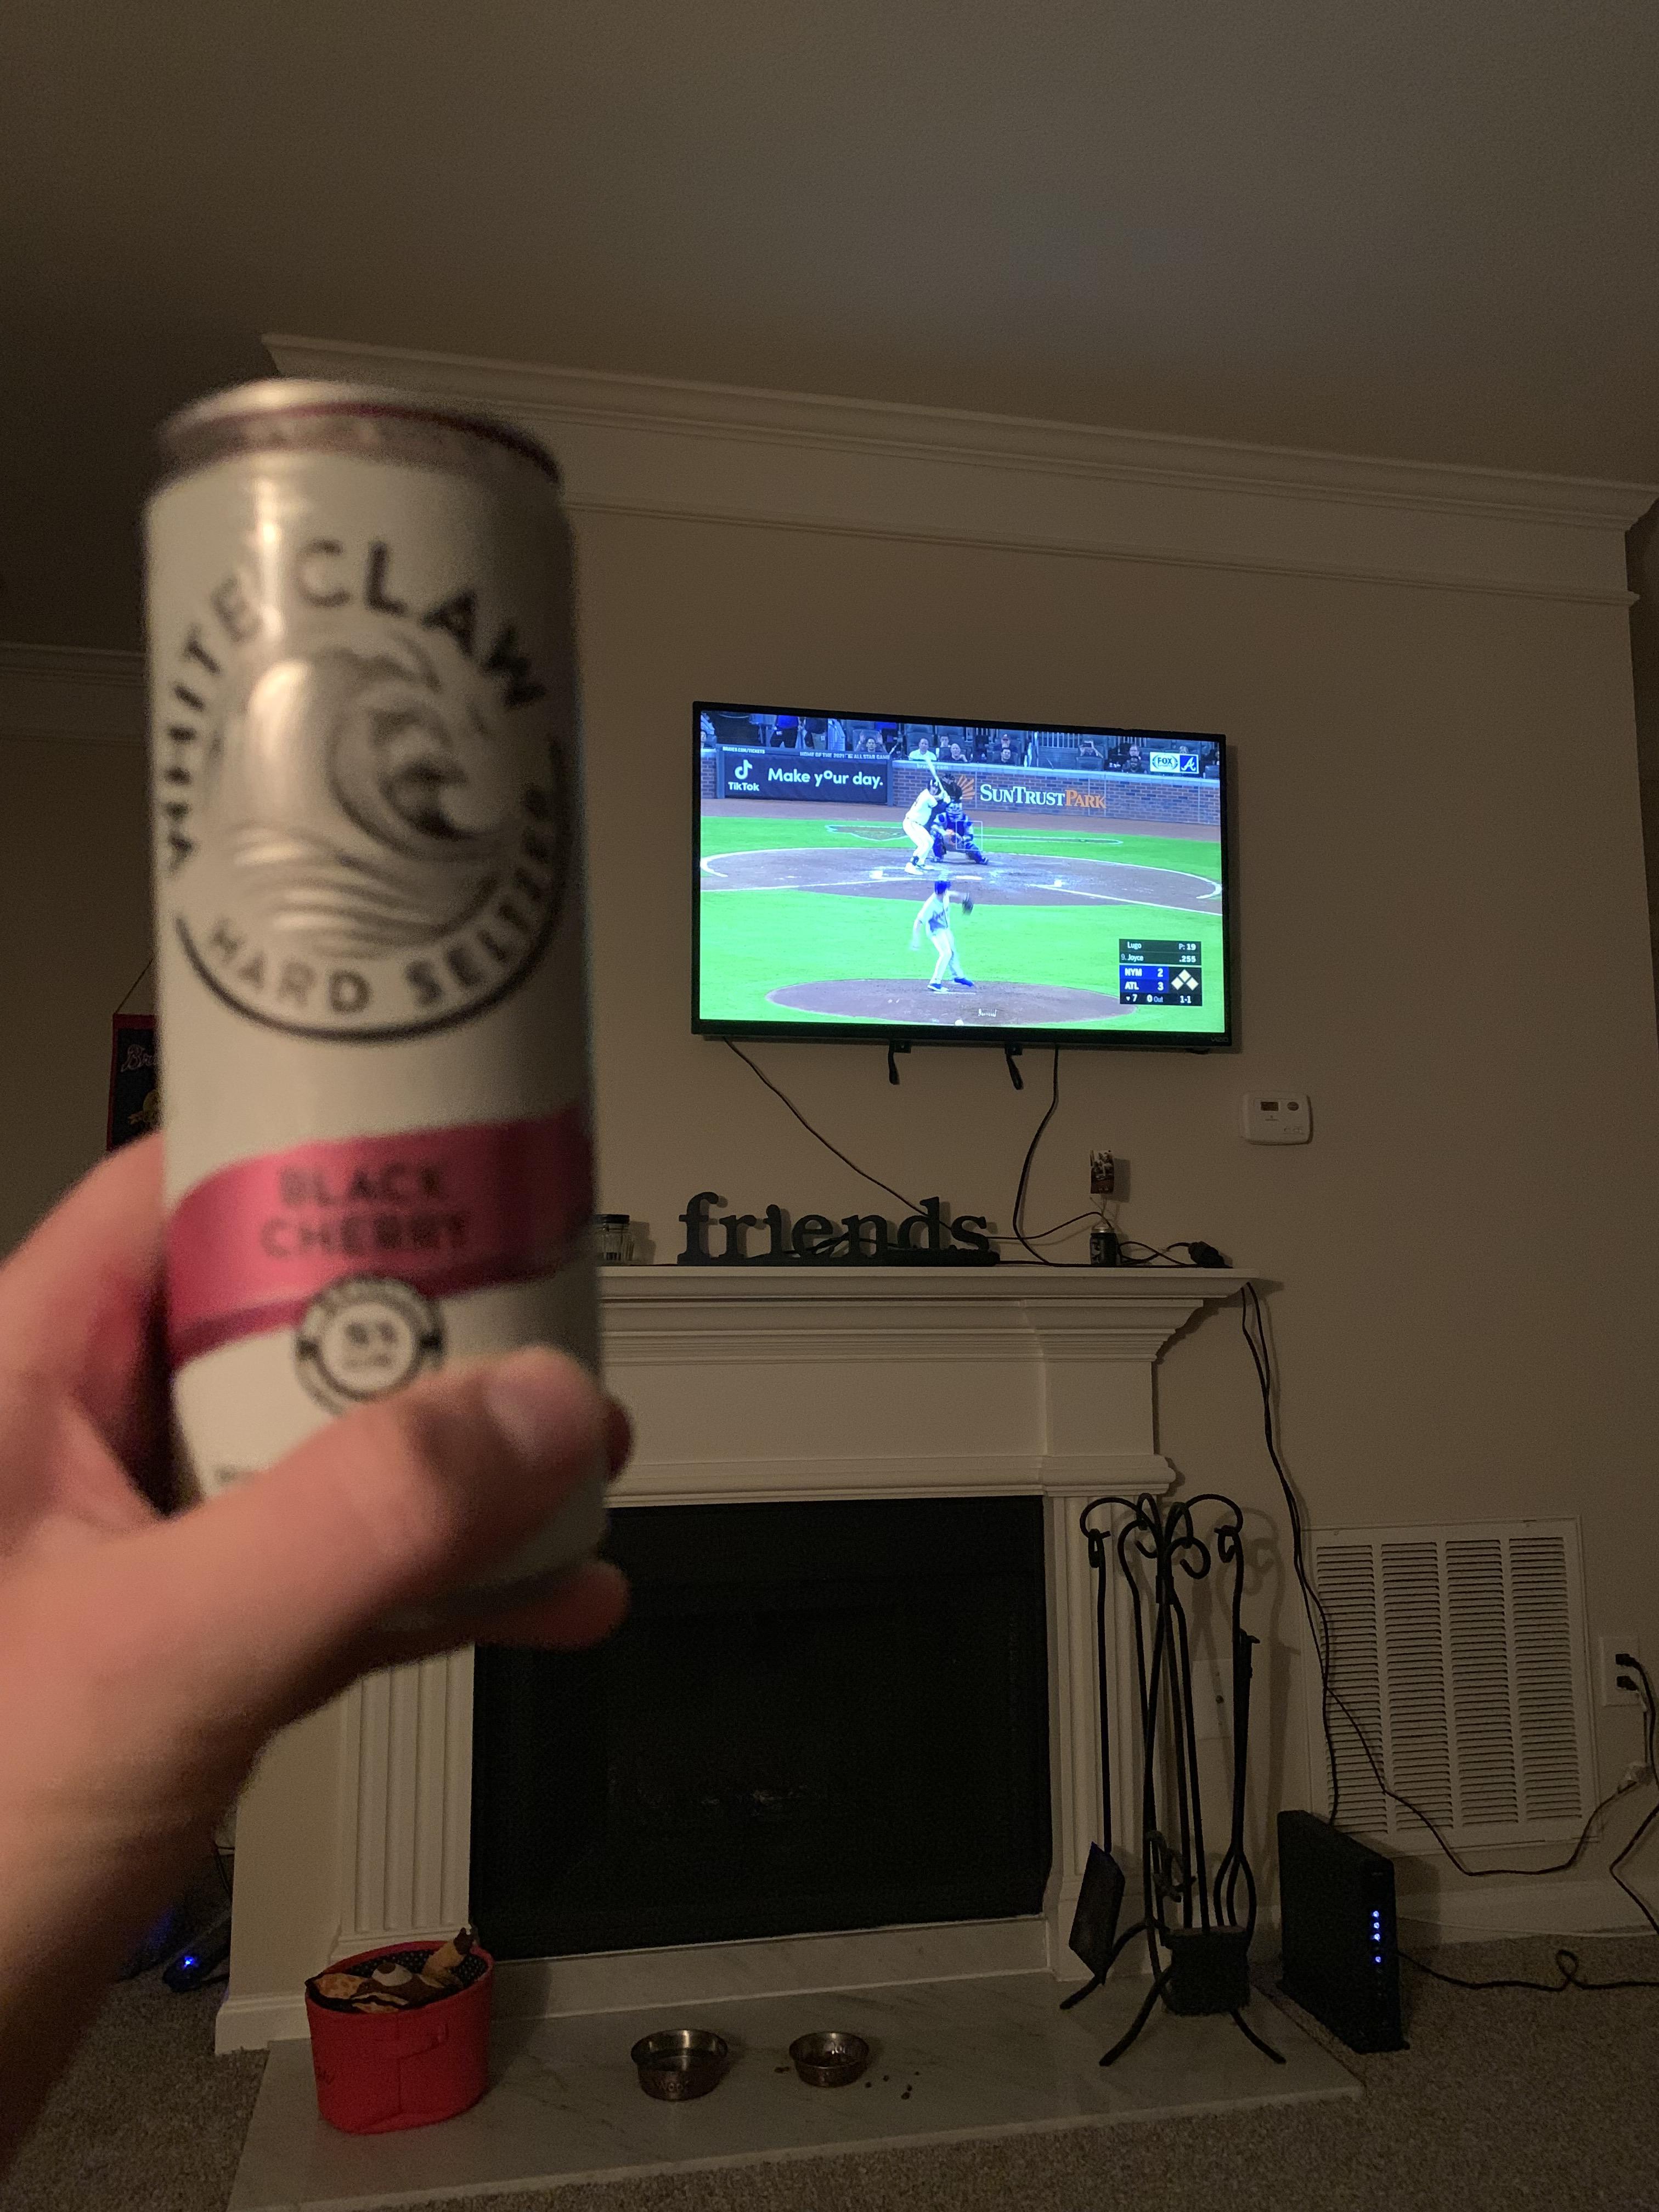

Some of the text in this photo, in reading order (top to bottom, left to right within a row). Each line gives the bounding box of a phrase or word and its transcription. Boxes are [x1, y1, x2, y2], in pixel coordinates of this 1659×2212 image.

[159, 537, 548, 878] WHITE CLAW
[728, 782, 759, 791] TikTok
[768, 768, 883, 789] Make your day.
[980, 784, 1107, 809] SUNTRUST PARK
[1127, 941, 1142, 950] Lugo
[208, 914, 372, 1015] HARD
[1157, 968, 1163, 977] 2
[1125, 981, 1164, 991] ATL 3
[1147, 994, 1153, 1002] 0
[1180, 995, 1191, 1003] 1-1
[276, 1161, 449, 1207] BLACK
[259, 1211, 470, 1260] CHERRY
[678, 1192, 992, 1265] friends
